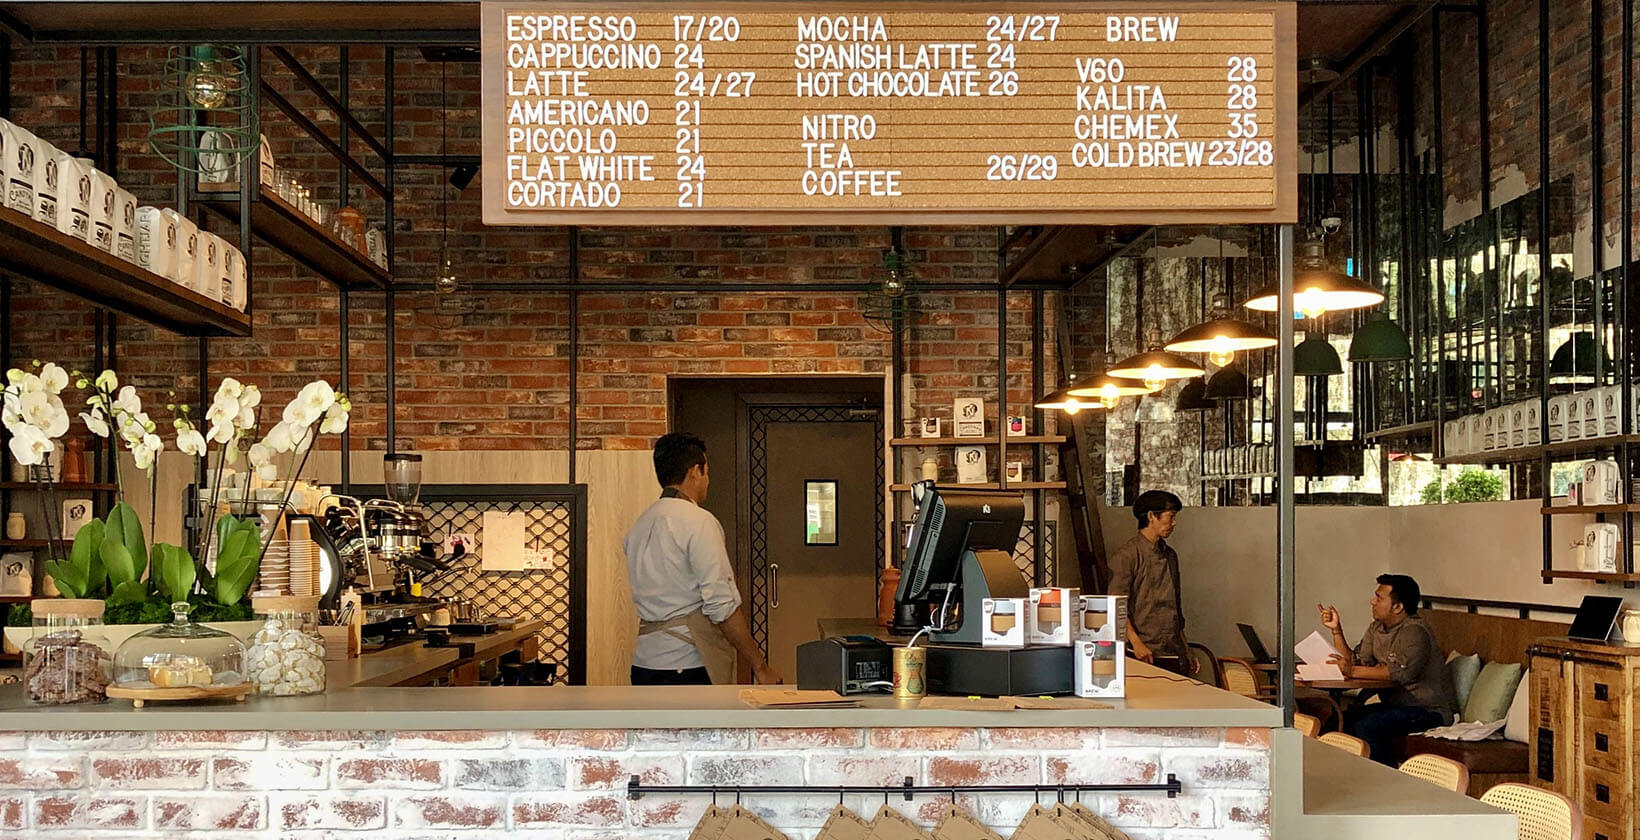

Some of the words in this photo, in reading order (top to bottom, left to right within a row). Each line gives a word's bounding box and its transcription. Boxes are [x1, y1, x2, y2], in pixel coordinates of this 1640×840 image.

[506, 14, 637, 42] ESPRESSO
[672, 15, 740, 42] 17/20
[797, 15, 888, 43] MOCHA
[986, 14, 1061, 42] 24/27
[1106, 15, 1180, 43] BREW
[507, 42, 662, 70] CAPPUCCINO
[673, 42, 705, 69] 24
[794, 42, 892, 71] SPANISH
[898, 43, 977, 71] LATTE
[986, 43, 1017, 70] 24
[1075, 57, 1125, 84] V60
[1226, 55, 1258, 83] 28
[507, 71, 590, 97] LATTE
[674, 70, 756, 98] 24/27
[796, 71, 844, 98] HOT
[847, 70, 982, 97] CHOCOLATE
[987, 69, 1019, 97] 26
[1076, 84, 1167, 112] KALITA
[1226, 83, 1258, 111] 28
[507, 98, 650, 126] AMERICANO
[675, 99, 701, 126] 21
[802, 113, 877, 142] NITRO
[1073, 113, 1180, 141] CHEMEX
[1226, 112, 1259, 139] 35
[508, 127, 617, 155] PICCOLO
[675, 127, 700, 154] 21
[1071, 141, 1135, 168] COLD
[1137, 140, 1206, 168] BREW
[1207, 138, 1274, 167] 23/28
[506, 155, 571, 182] FLAT
[577, 155, 655, 182] WHITE
[676, 154, 707, 181] 24
[801, 142, 854, 169] TEA
[986, 153, 1058, 181] 26/29
[507, 181, 622, 208] CORTADO
[677, 181, 704, 208] 21
[801, 169, 902, 197] COFFEE
[139, 212, 151, 269] IGHTJAR
